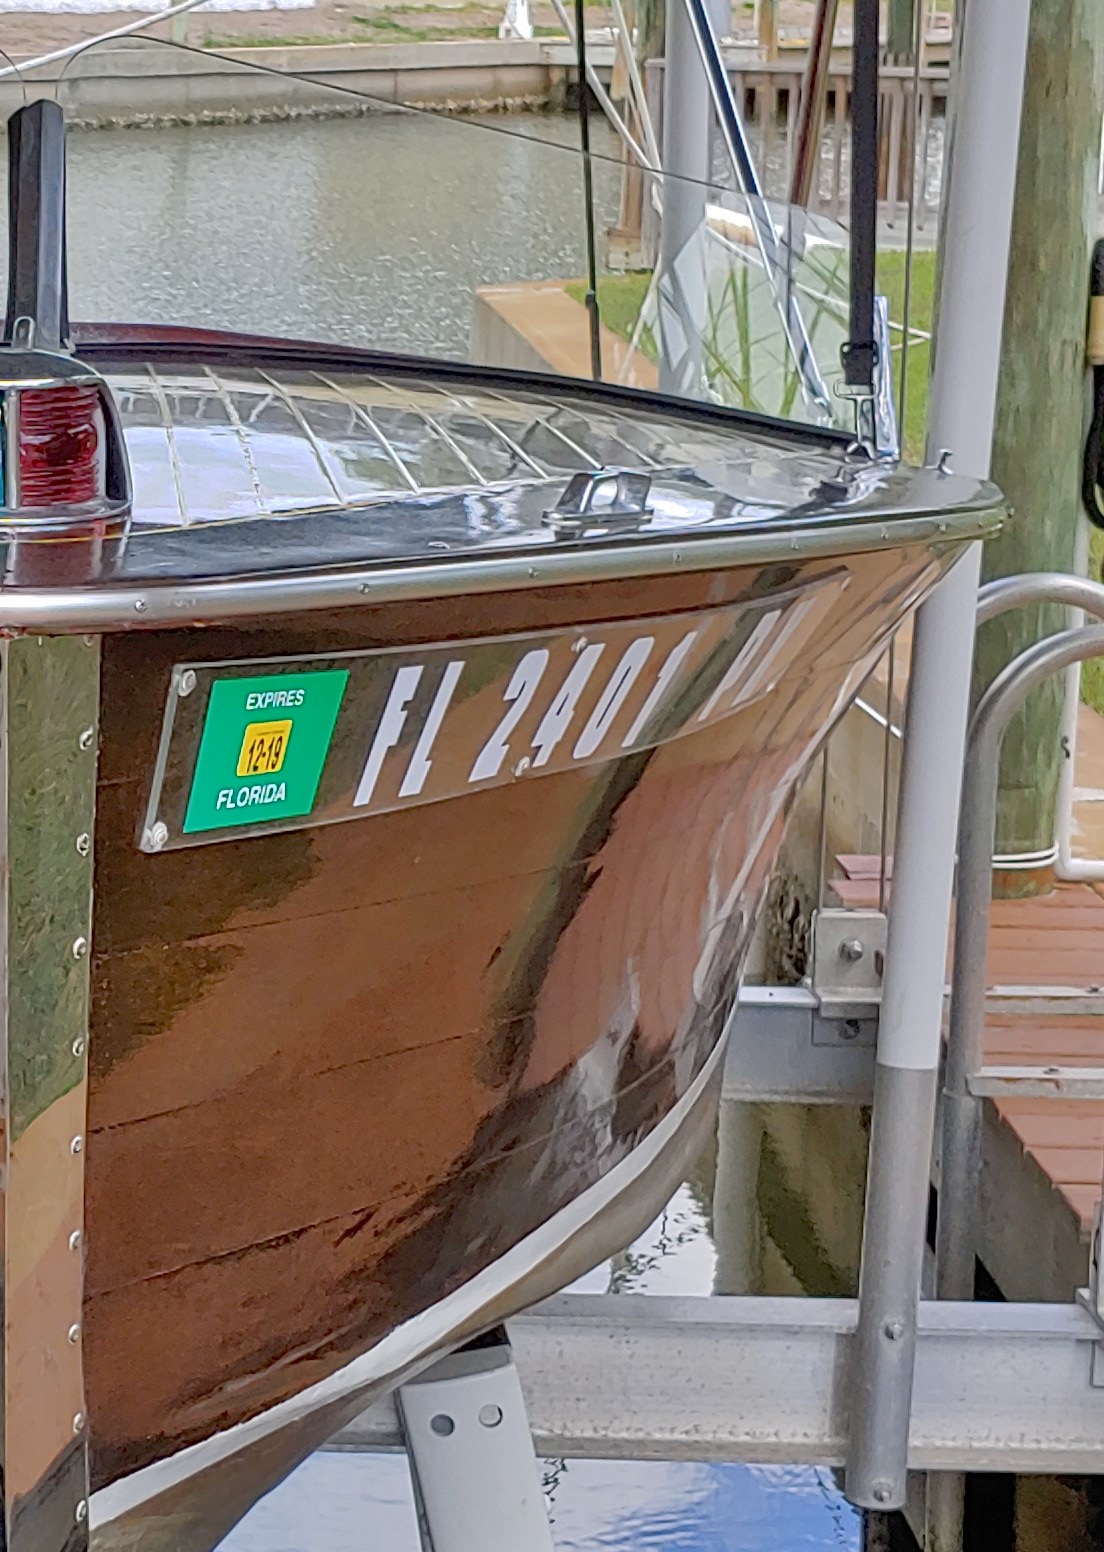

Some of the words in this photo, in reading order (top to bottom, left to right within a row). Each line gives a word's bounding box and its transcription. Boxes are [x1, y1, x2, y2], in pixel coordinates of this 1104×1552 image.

[246, 689, 305, 710] EXPIRES
[353, 660, 465, 807] FL
[468, 630, 698, 783] 2401
[246, 736, 283, 774] 12-19
[216, 782, 286, 810] FLORIDA
